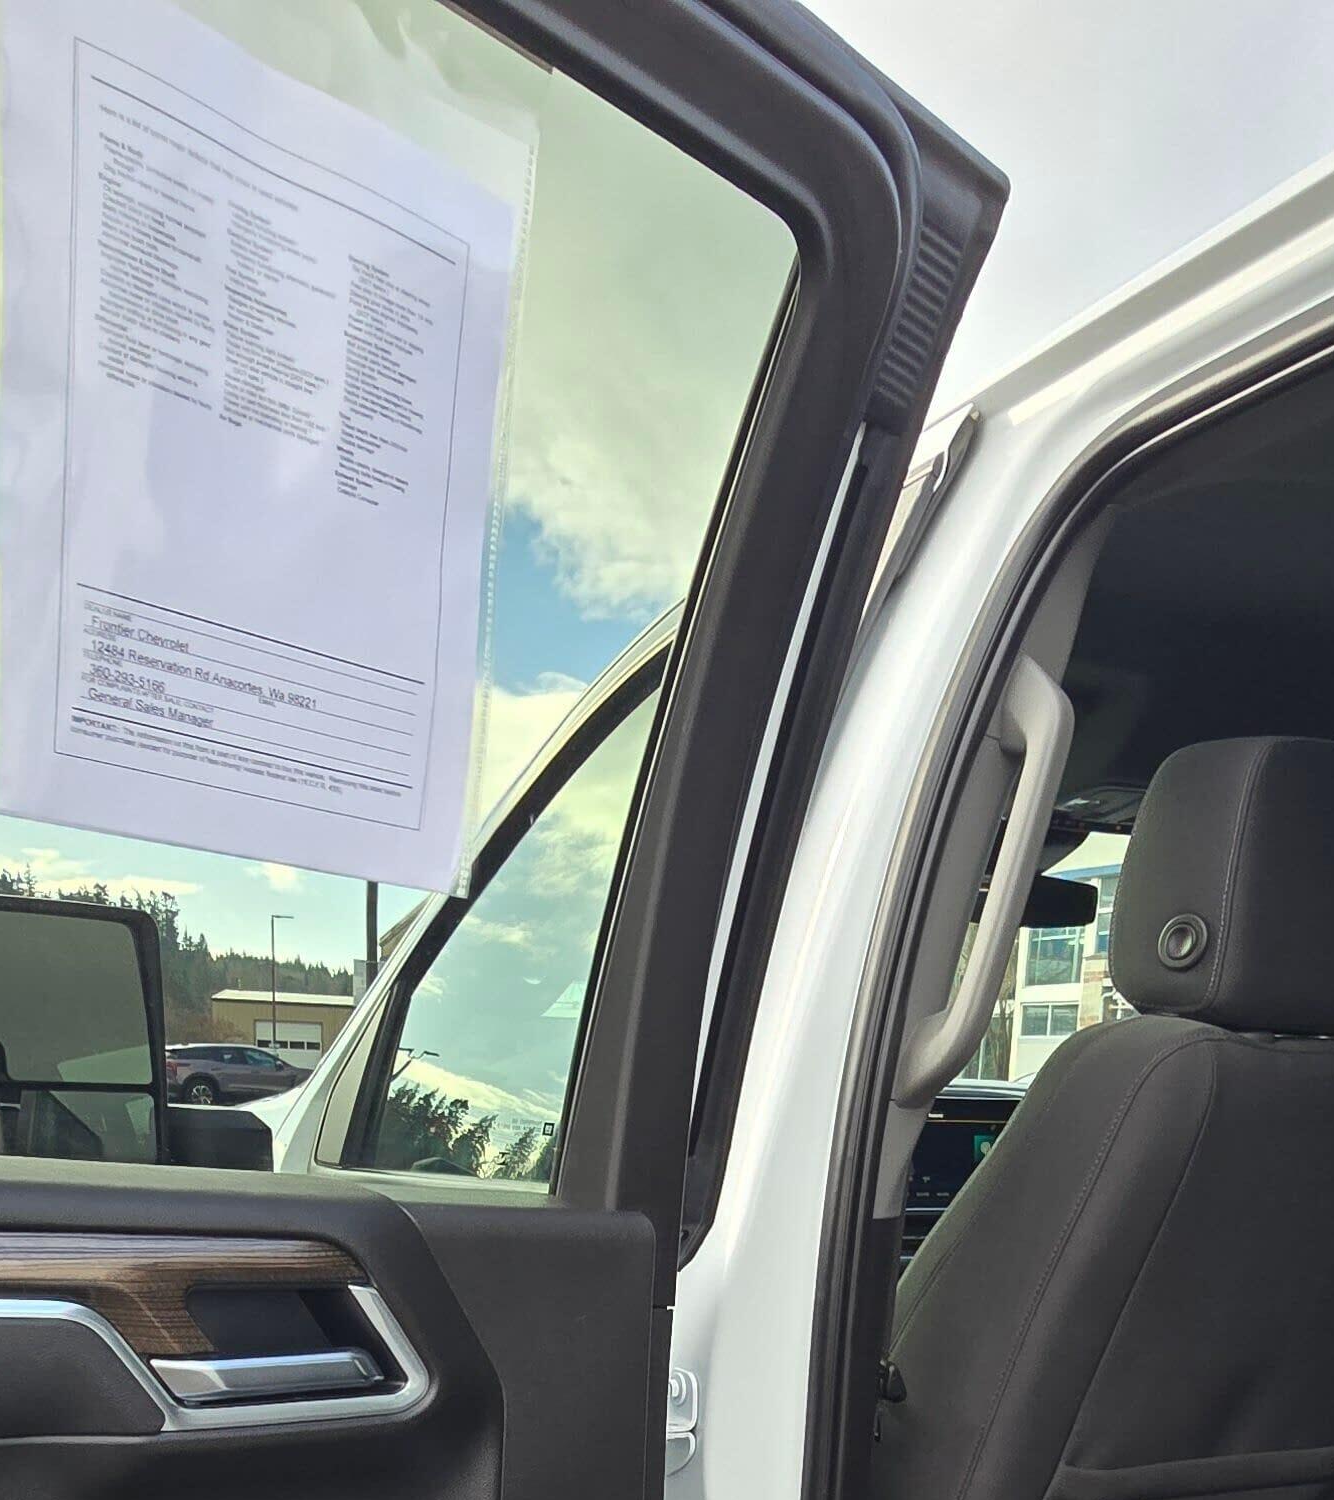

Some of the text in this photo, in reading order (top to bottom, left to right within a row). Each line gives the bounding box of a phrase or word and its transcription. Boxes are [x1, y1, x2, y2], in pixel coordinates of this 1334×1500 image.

[91, 615, 135, 637] Frontier
[137, 628, 189, 653] Chevrolet
[128, 649, 192, 674] Reservation
[194, 667, 210, 681] Rd
[268, 687, 285, 702] Wa
[87, 687, 214, 729] General Sales Manager
